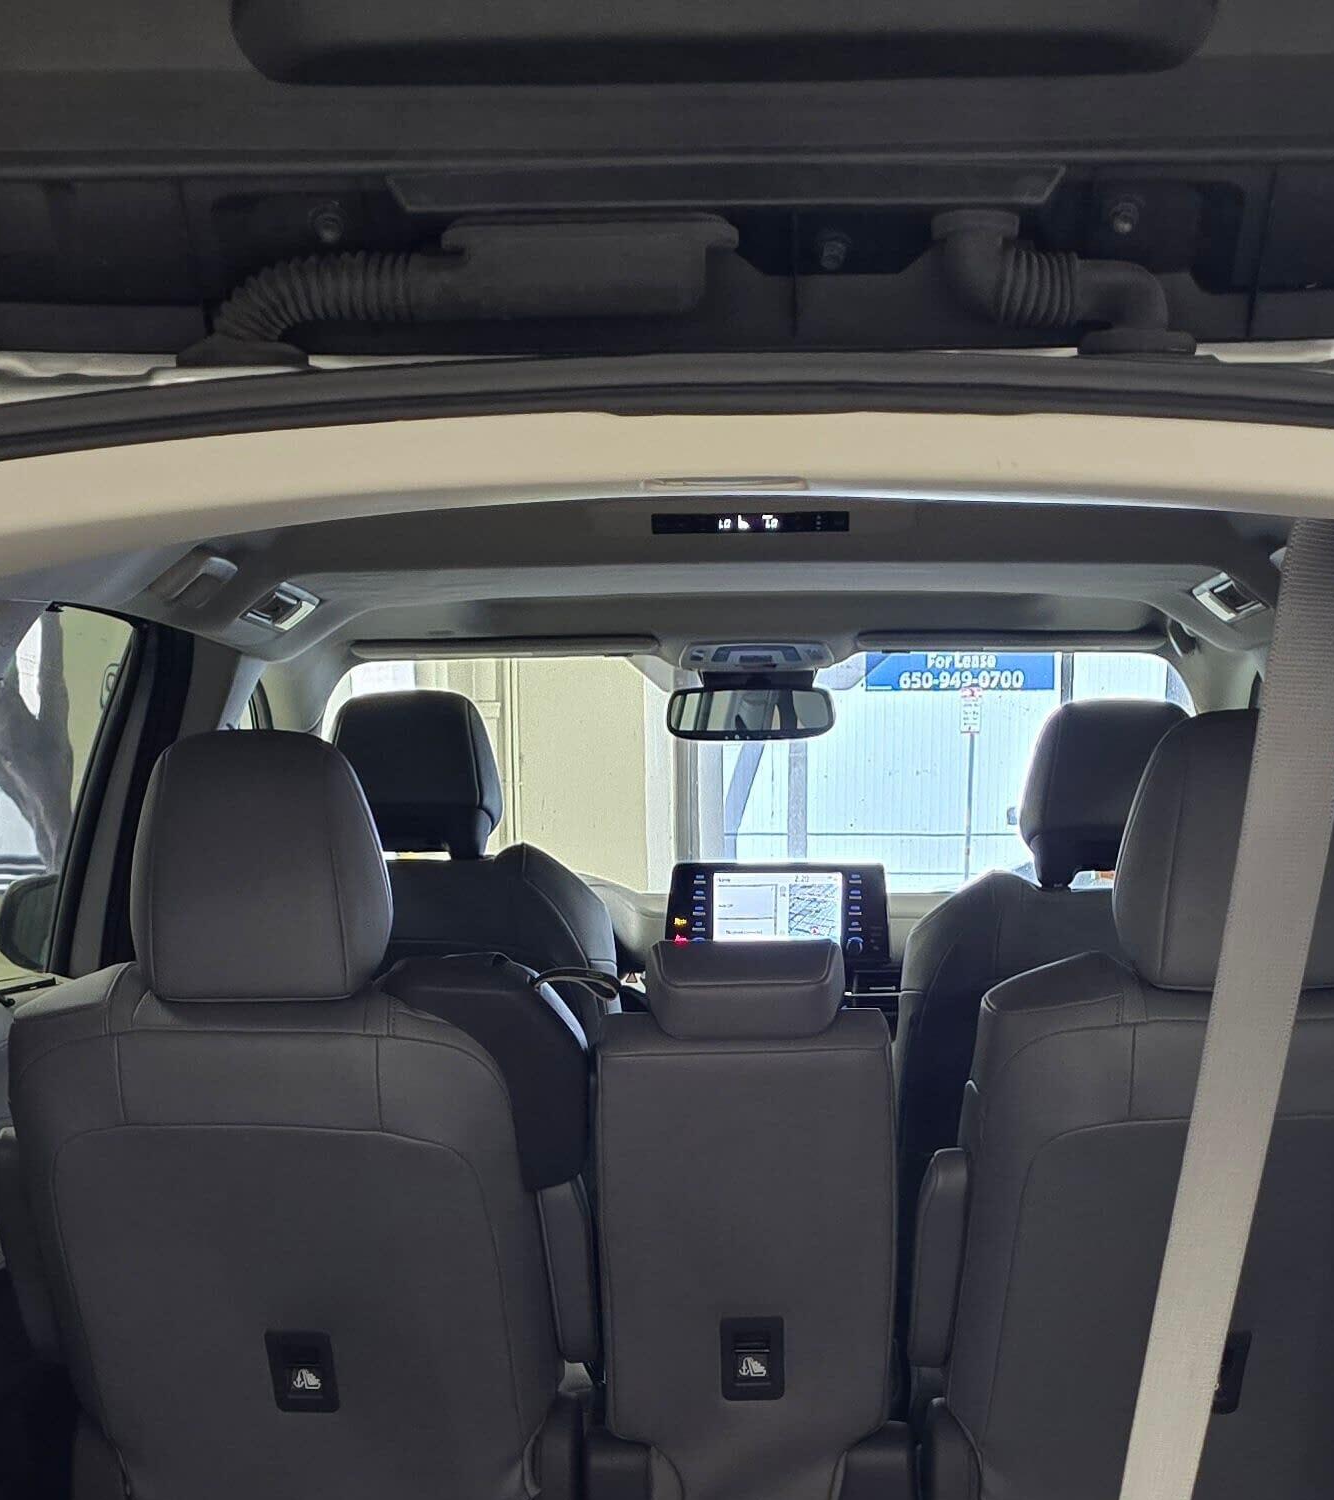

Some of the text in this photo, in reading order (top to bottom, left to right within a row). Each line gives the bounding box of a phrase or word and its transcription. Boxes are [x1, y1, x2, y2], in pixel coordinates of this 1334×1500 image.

[927, 653, 997, 669] For Lease
[899, 670, 1025, 689] 650-949-0700
